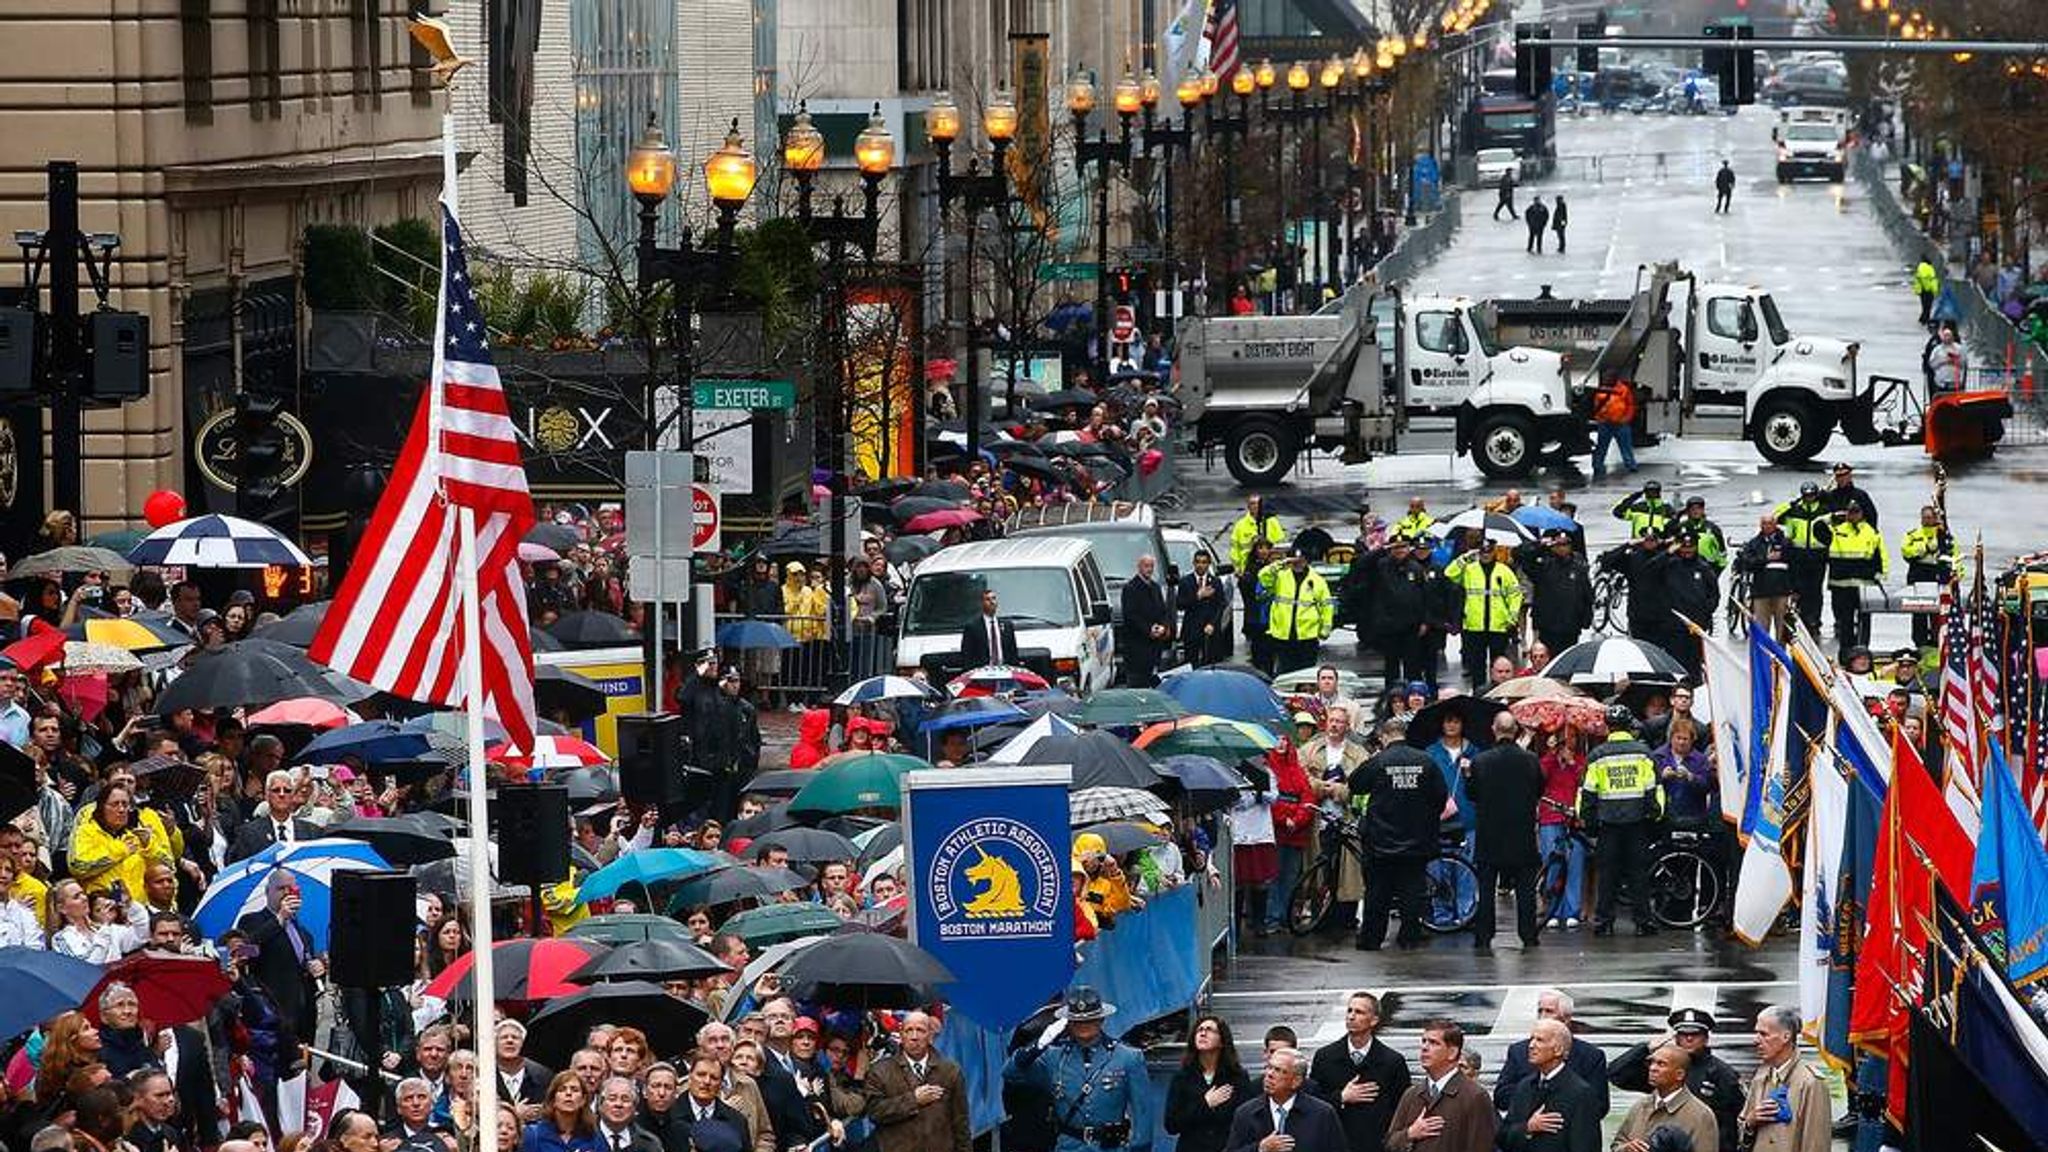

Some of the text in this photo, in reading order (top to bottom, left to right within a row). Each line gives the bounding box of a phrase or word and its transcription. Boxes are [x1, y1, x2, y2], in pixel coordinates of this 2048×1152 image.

[1245, 342, 1315, 358] DISTRICT EIGHT
[1433, 368, 1470, 378] Boston
[714, 388, 769, 407] EXETER
[1608, 766, 1638, 777] BOSTON
[1392, 774, 1418, 789] POLICE
[1609, 778, 1636, 789] POLICE
[934, 823, 1054, 912] BOSTON ATHLETIC ASSOCIATION
[940, 920, 1053, 936] BOSTON MARATHON
